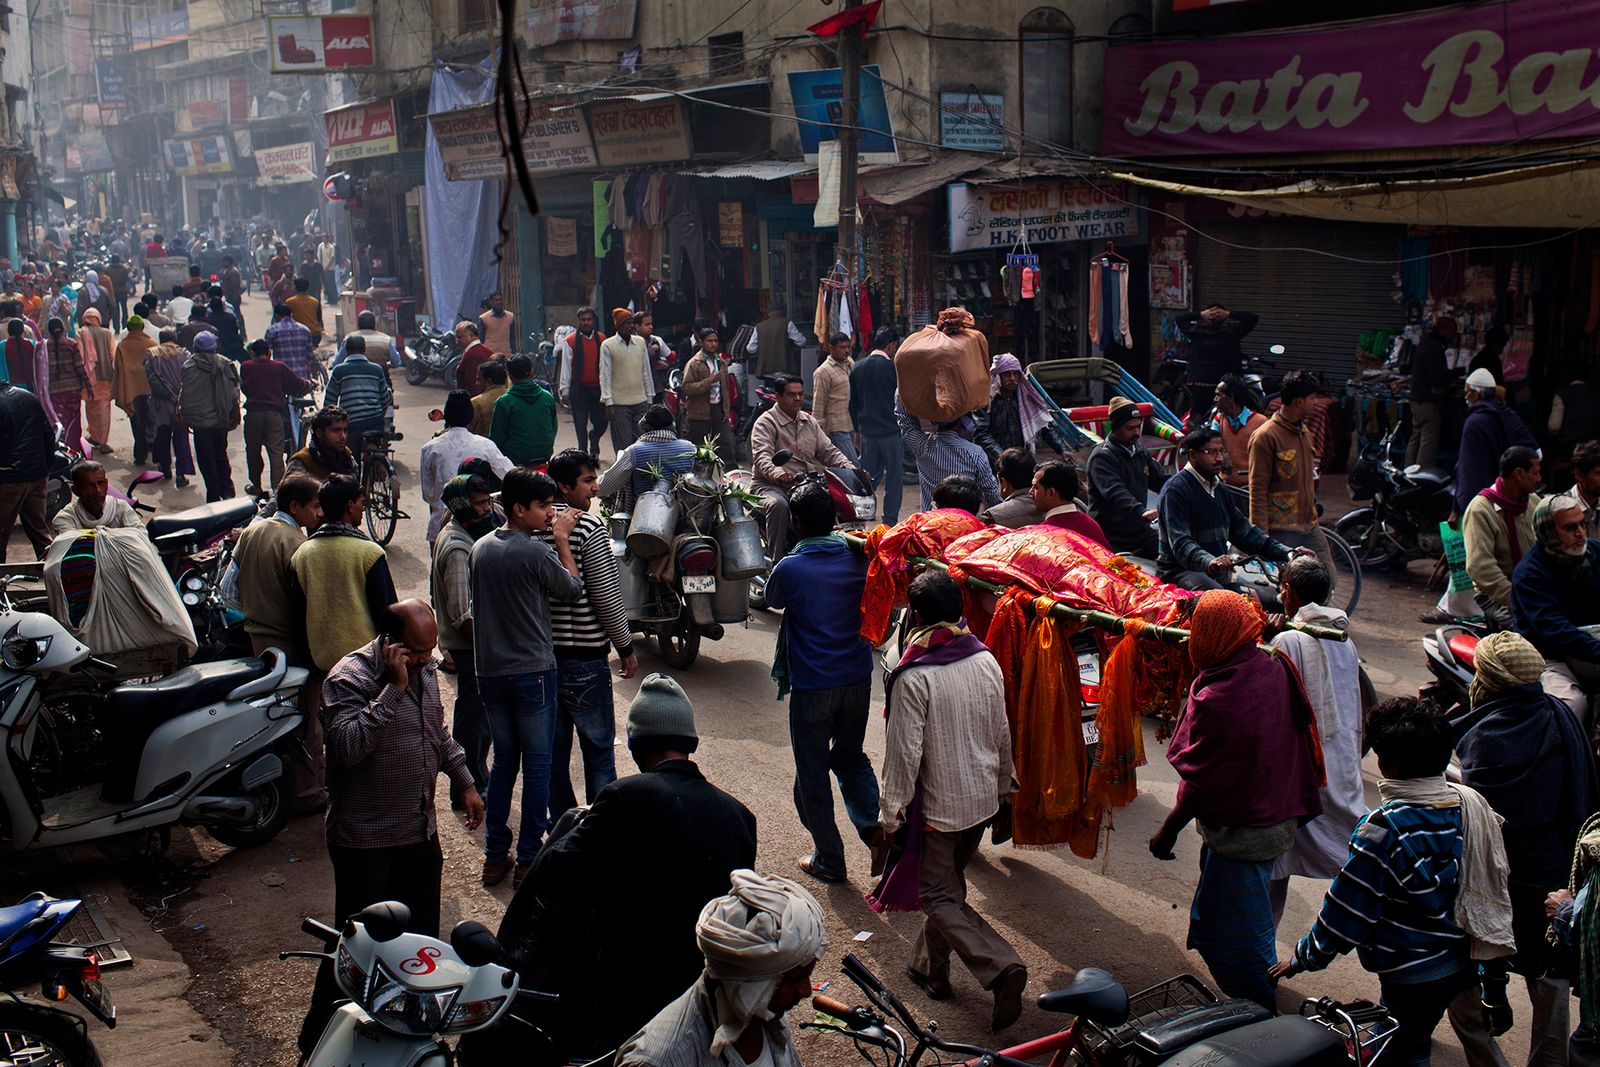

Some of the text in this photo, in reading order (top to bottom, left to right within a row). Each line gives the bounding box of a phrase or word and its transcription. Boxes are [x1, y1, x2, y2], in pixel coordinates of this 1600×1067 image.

[325, 36, 369, 49] ALFA
[1124, 30, 1600, 137] Bata Ba
[370, 120, 392, 136] ALFA
[1027, 226, 1069, 242] FOOT
[1075, 222, 1126, 239] WEAR
[399, 946, 441, 976] S
